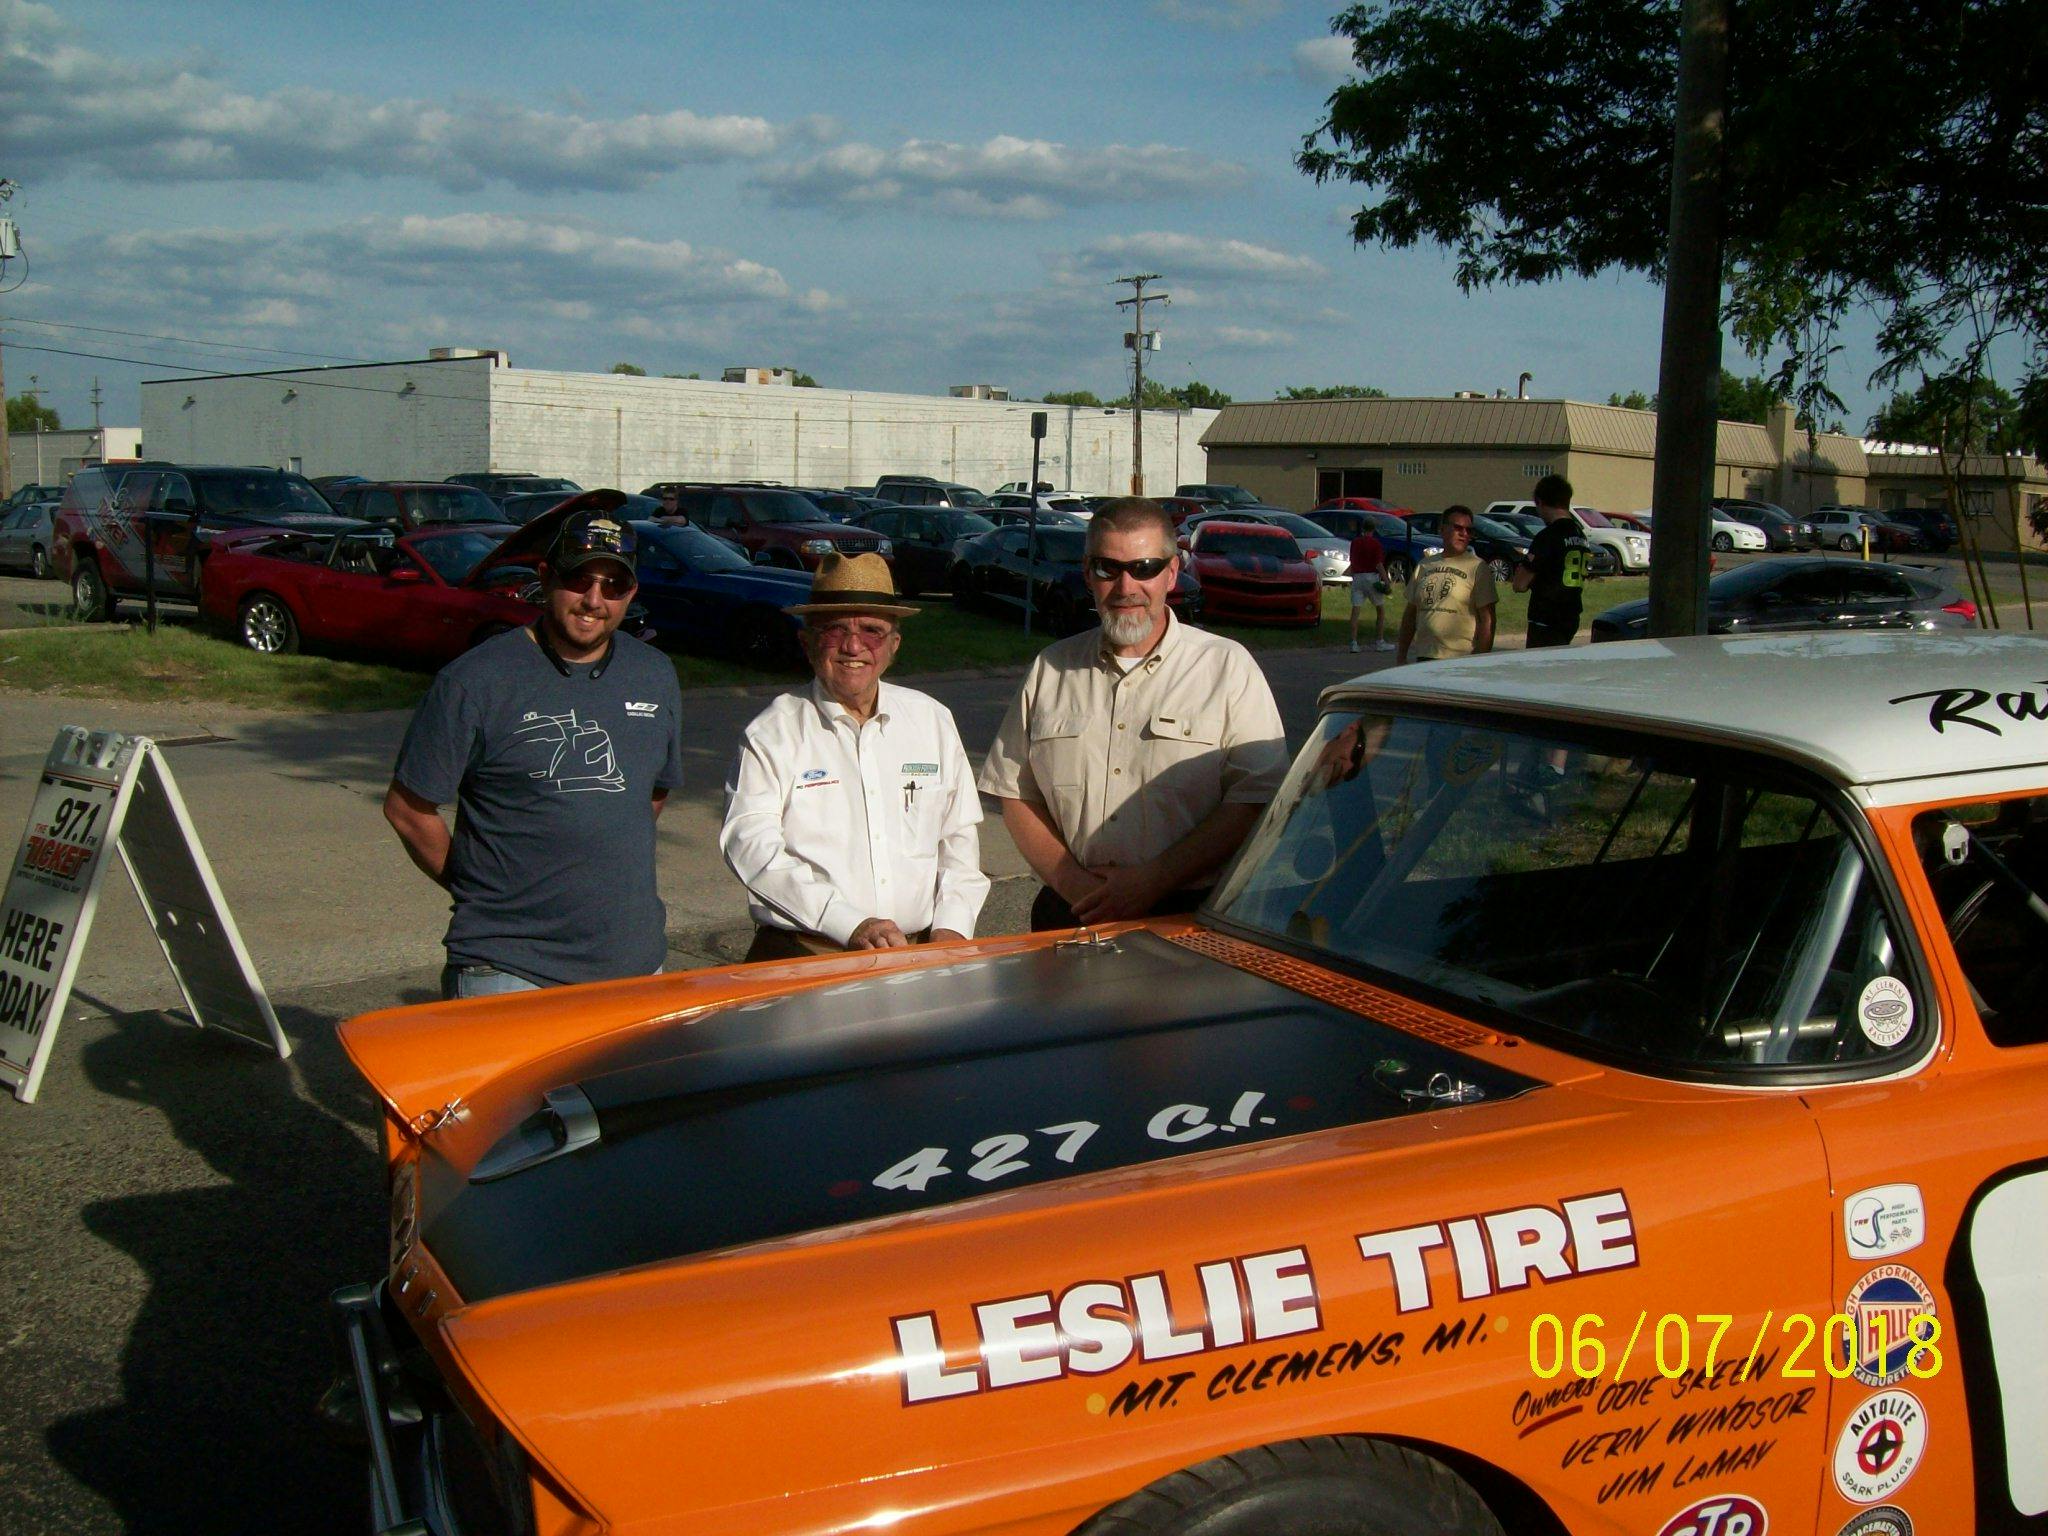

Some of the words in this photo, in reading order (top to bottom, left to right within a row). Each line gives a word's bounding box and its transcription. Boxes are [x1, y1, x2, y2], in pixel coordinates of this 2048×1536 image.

[49, 798, 102, 843] 97.1
[23, 836, 93, 880] TICKET
[0, 908, 64, 972] HERE
[872, 1120, 1100, 1192] 427
[890, 1243, 1325, 1407] LESLIE
[1355, 1187, 1641, 1316] TIRE
[1859, 1266, 1934, 1311] PERFORMANCE
[1107, 1370, 1196, 1418] MT.
[1206, 1331, 1405, 1401] CLEMENS,
[1422, 1313, 1489, 1356] MI.
[1596, 1374, 1664, 1415] ODIE
[1561, 1418, 1661, 1470] VERN
[1666, 1387, 1816, 1445] WINDSOR
[1850, 1398, 1917, 1437] AUTOLITE
[1597, 1461, 1665, 1505] JIM
[1842, 1471, 1874, 1496] SPARK
[1877, 1456, 1913, 1493] PLUGS
